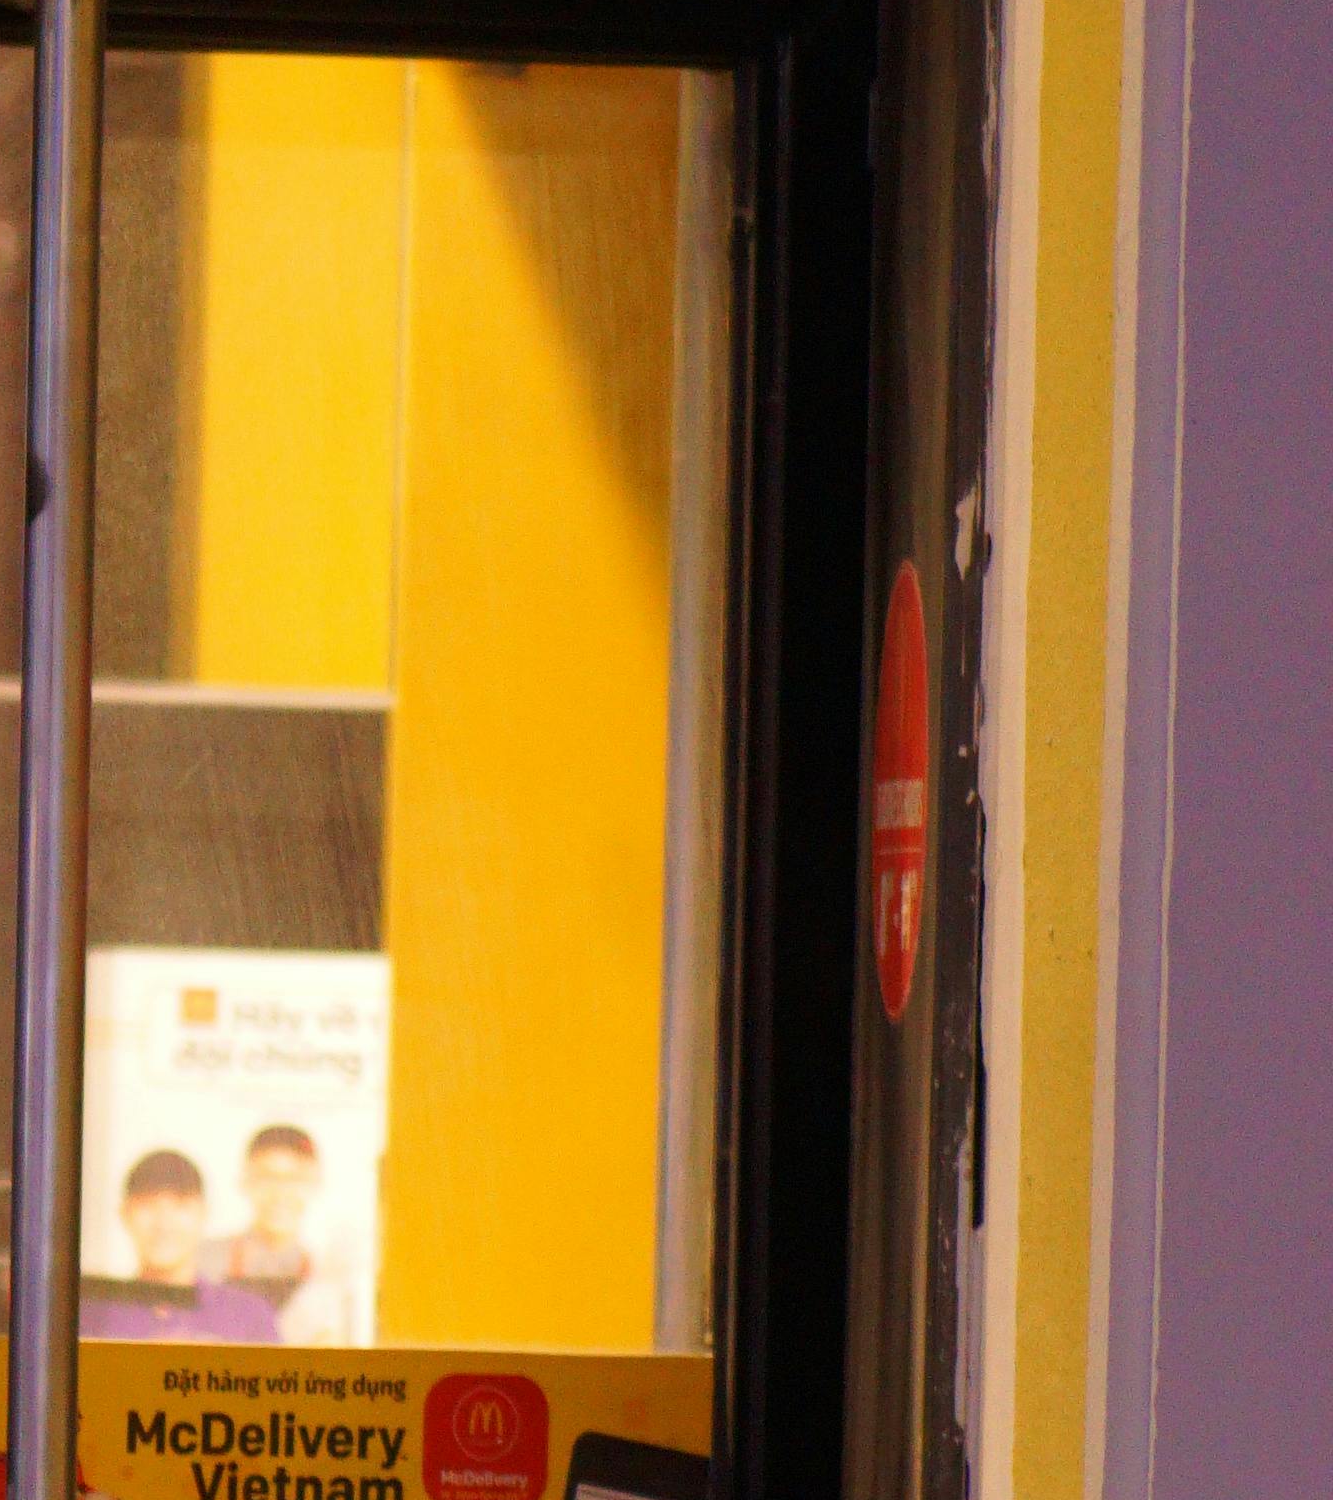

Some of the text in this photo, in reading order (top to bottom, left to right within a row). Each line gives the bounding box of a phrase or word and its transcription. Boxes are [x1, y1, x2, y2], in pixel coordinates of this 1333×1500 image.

[163, 1369, 200, 1396] Đặt
[206, 1369, 260, 1398] hàng
[352, 1373, 406, 1402] dụng
[125, 1409, 406, 1470] McDelivery
